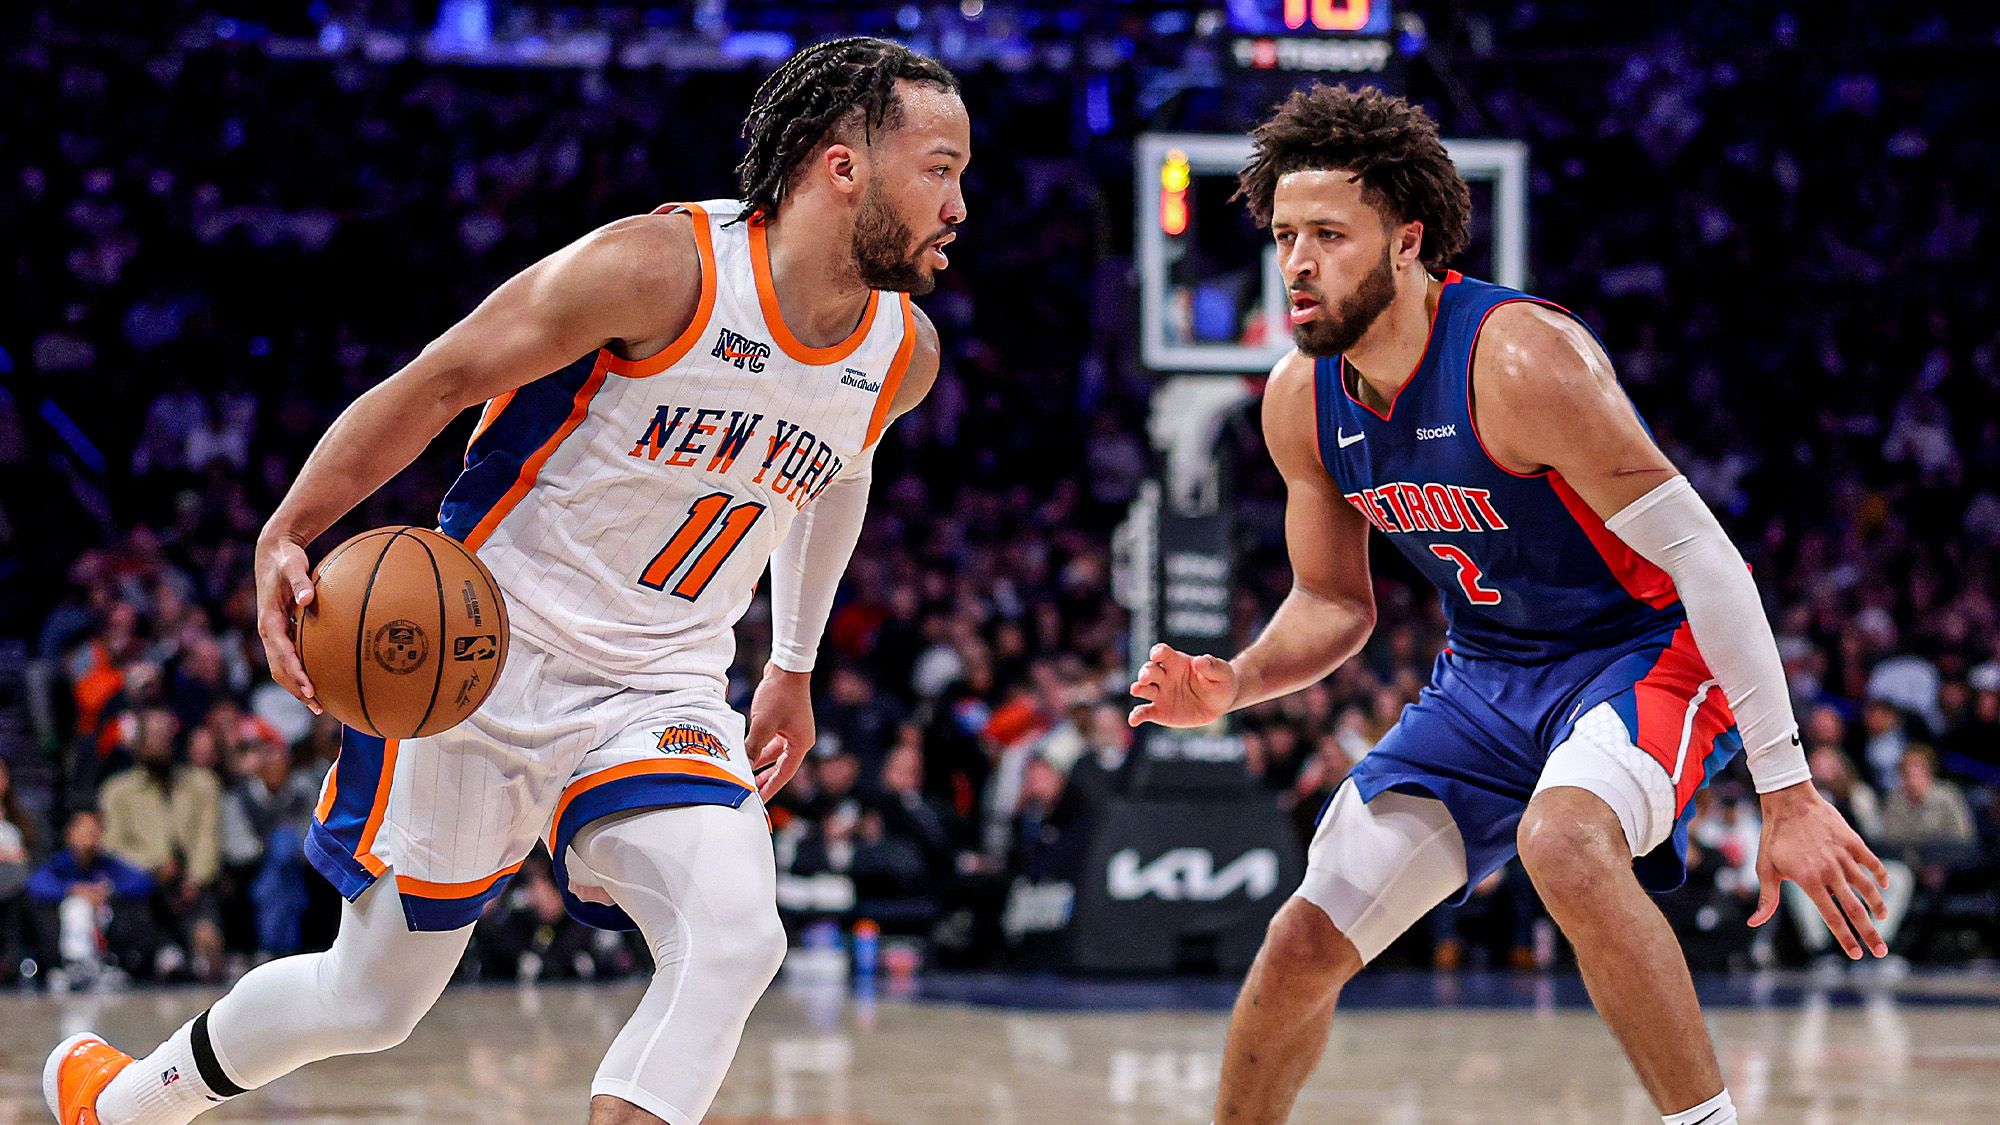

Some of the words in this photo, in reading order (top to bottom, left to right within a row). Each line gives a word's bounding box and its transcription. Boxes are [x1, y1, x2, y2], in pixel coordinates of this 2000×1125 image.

[711, 327, 771, 373] NYC
[840, 375, 858, 388] abu
[857, 378, 881, 393] dhabi
[1416, 423, 1457, 441] StockX
[628, 405, 764, 474] NEW
[752, 418, 843, 511] YORK
[637, 491, 767, 603] 11
[1429, 543, 1502, 606] 2
[656, 725, 731, 761] KNICKS
